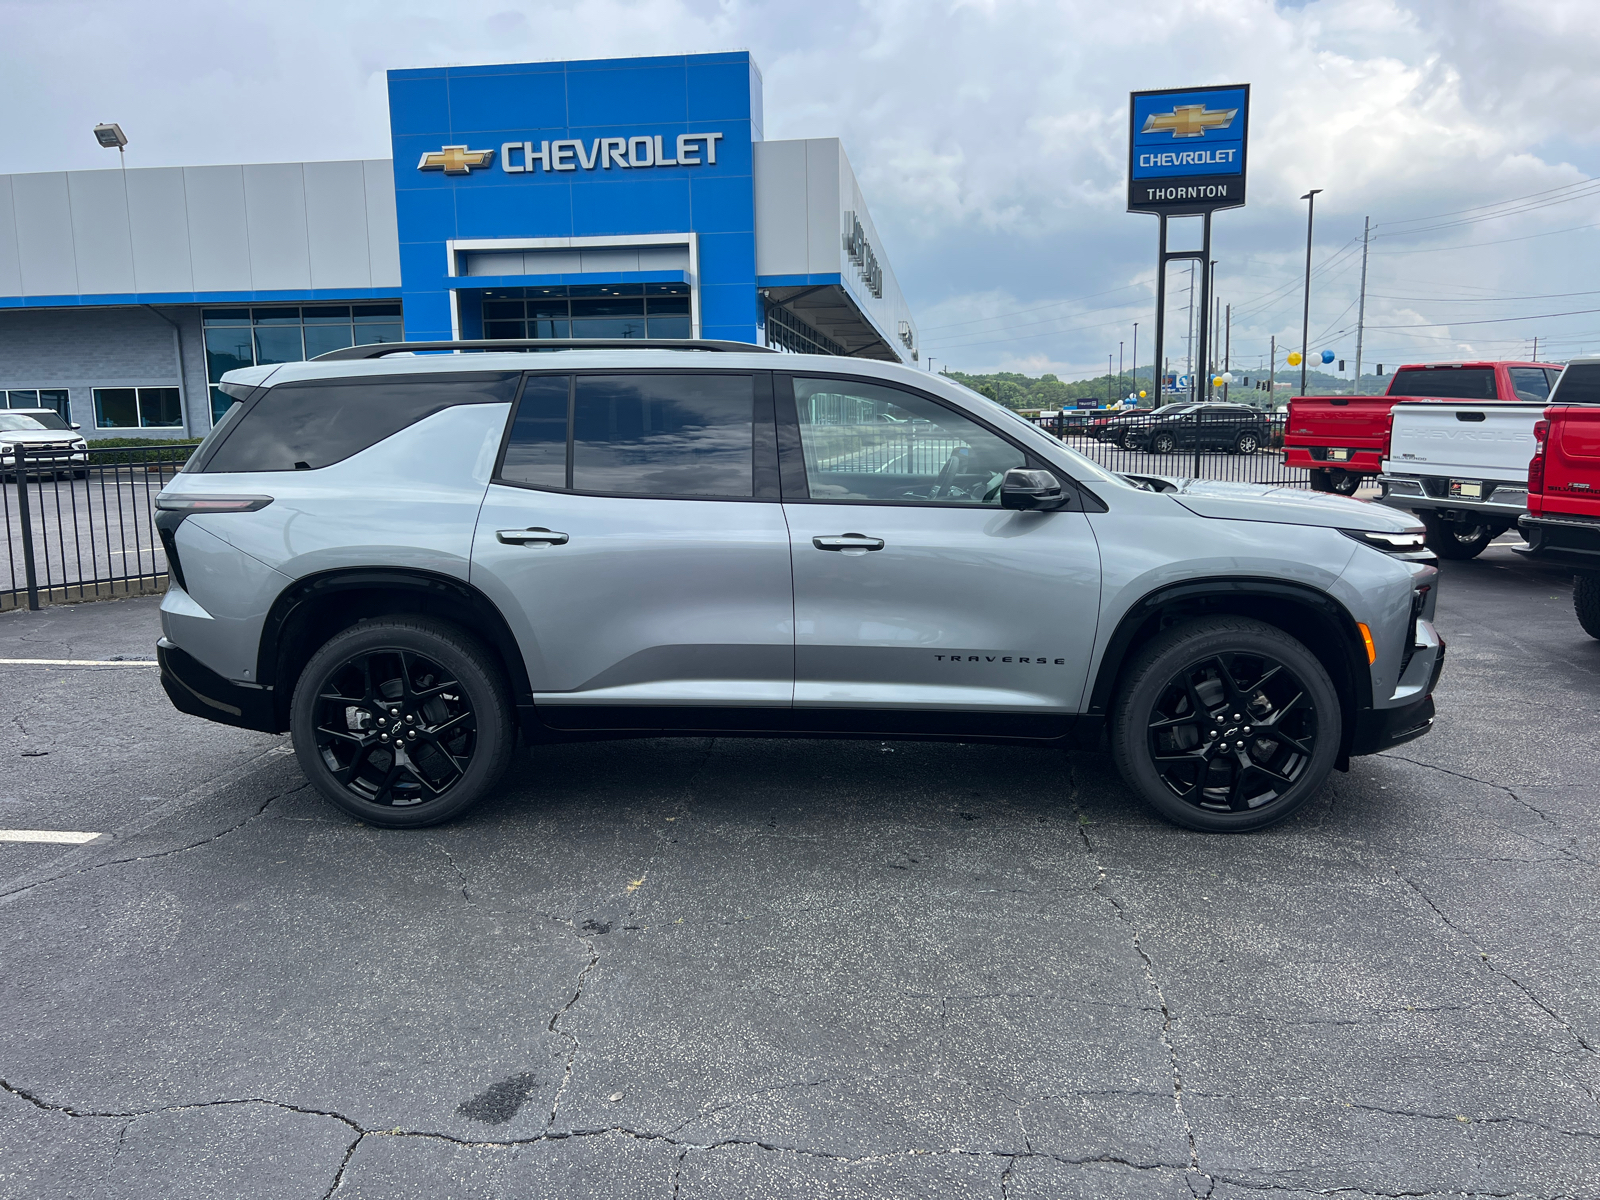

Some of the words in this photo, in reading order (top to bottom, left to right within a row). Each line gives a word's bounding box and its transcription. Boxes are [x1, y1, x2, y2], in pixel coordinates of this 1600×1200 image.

[501, 132, 723, 173] CHEVROLET
[1139, 149, 1237, 167] CHEVROLET
[1146, 184, 1228, 200] THORNTON
[934, 655, 1066, 665] TRAVERSE
